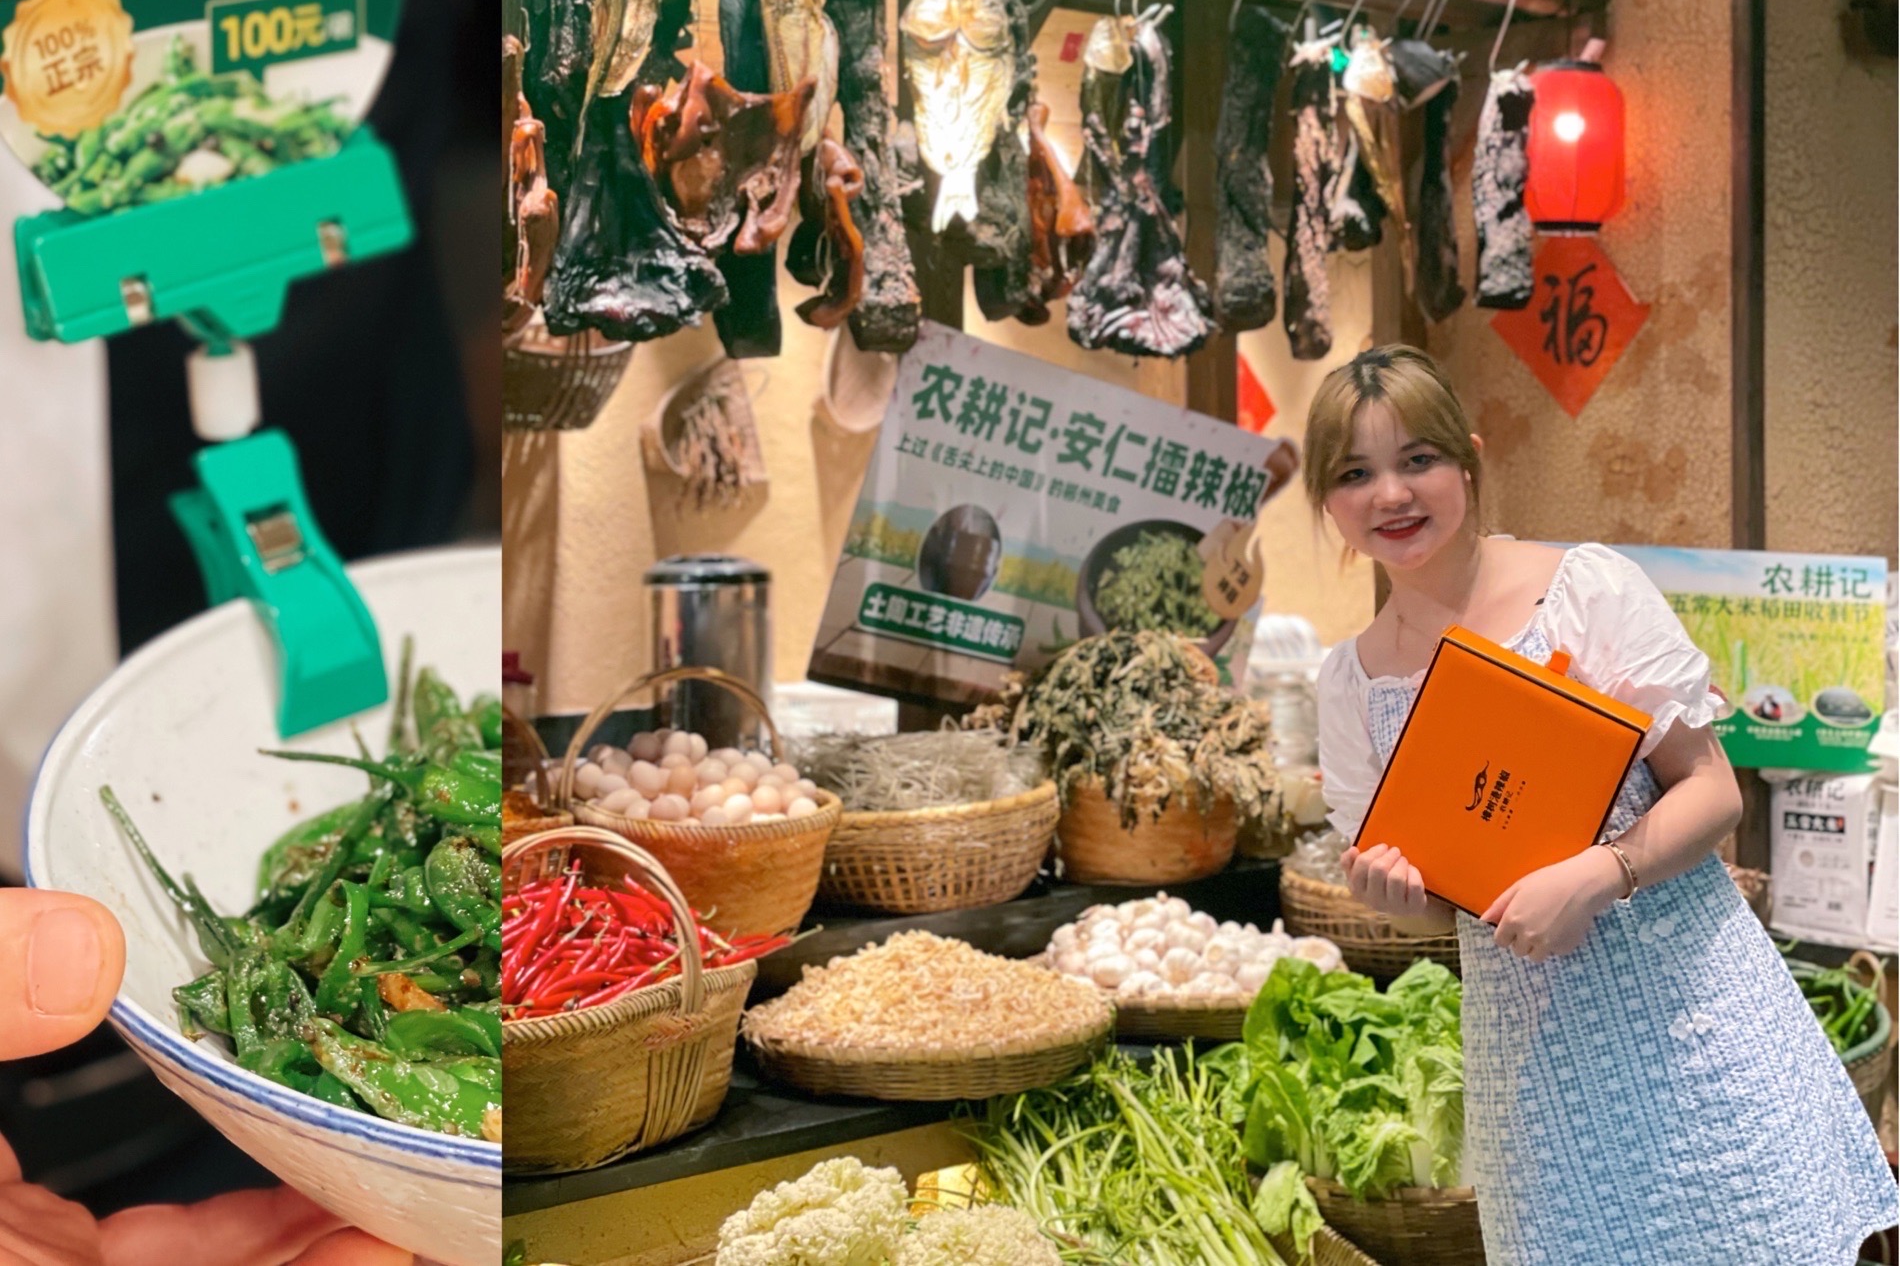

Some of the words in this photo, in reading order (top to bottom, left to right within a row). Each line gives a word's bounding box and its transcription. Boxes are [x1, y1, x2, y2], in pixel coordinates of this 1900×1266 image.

[33, 20, 97, 59] 100%
[42, 47, 105, 96] 正宗
[1540, 264, 1608, 369] 福
[1761, 563, 1872, 600] 农耕记
